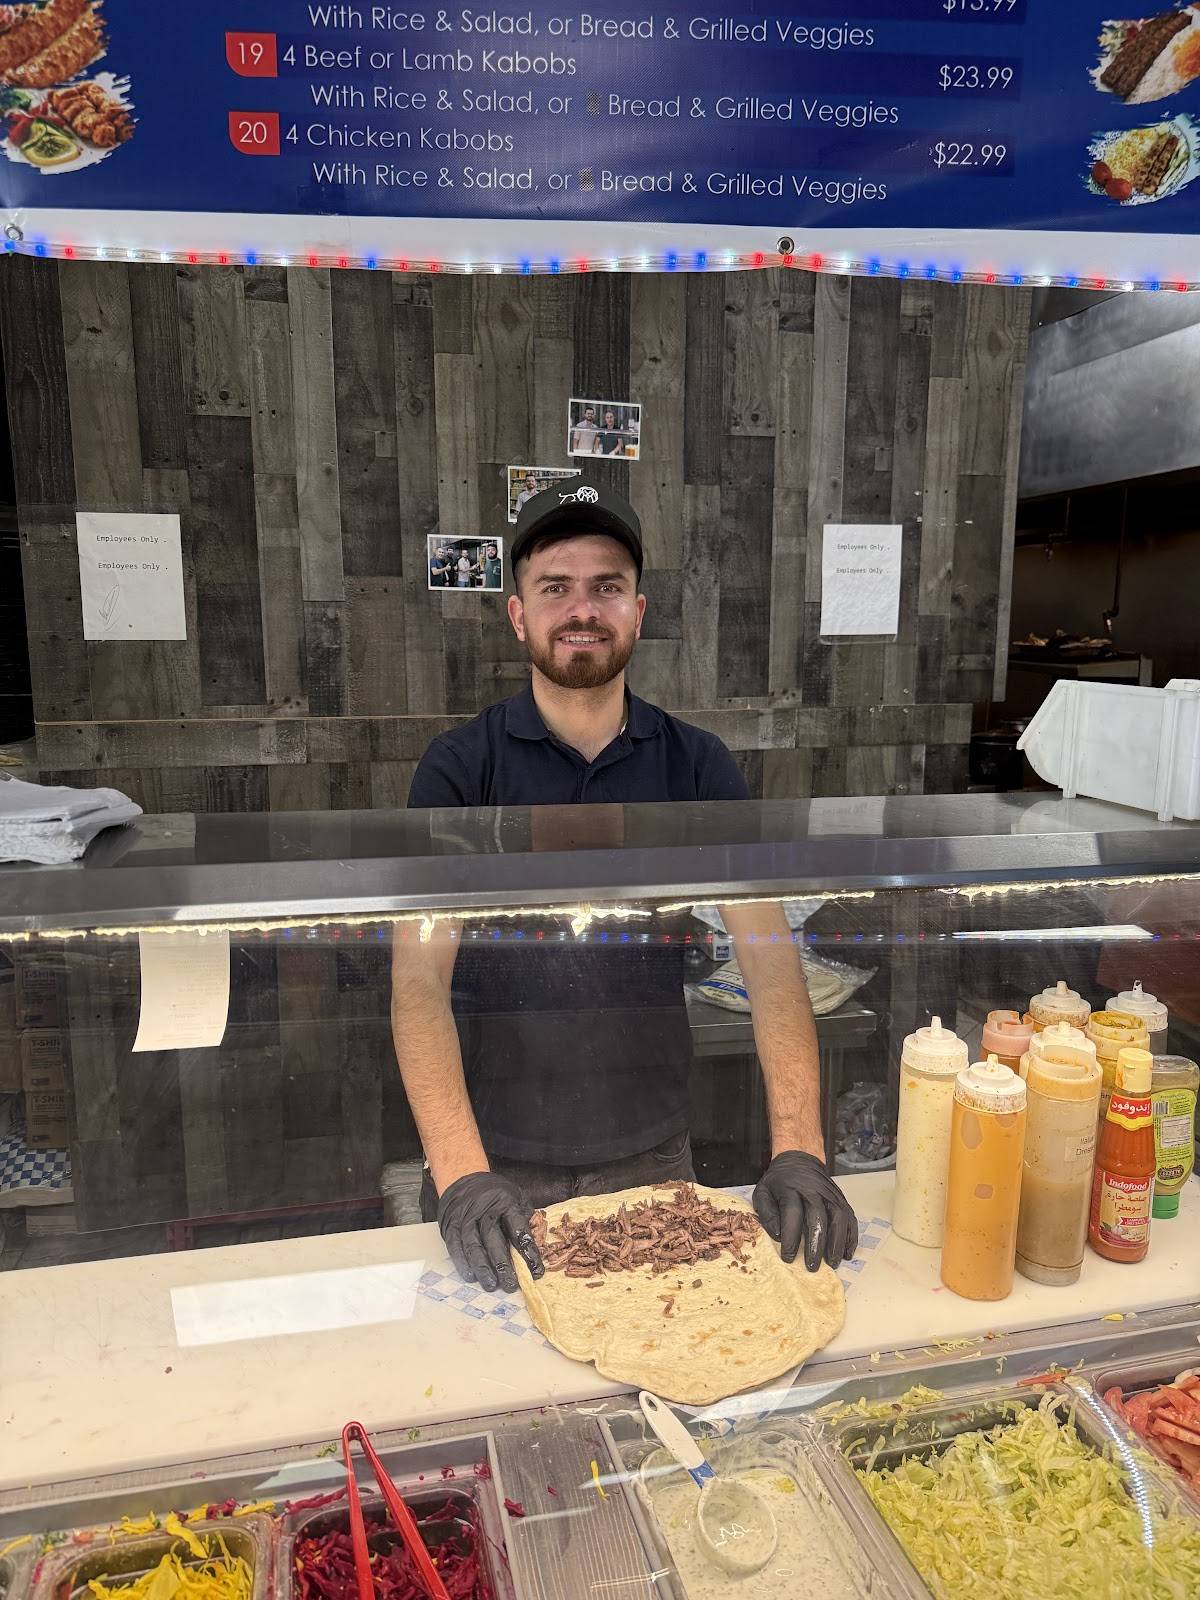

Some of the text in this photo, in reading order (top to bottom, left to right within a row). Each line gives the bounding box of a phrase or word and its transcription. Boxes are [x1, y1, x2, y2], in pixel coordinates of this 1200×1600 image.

[308, 4, 874, 50] With Rice & Salad, or Bread & Grilled Veggies
[238, 42, 577, 76] 19 4 Beef or Lamb Kabobs
[938, 63, 1013, 91] $23.99
[310, 84, 899, 128] With Rice & Salad, or Bread & Grilled Veggies
[238, 121, 514, 153] 20 4 Chicken Kabobs
[933, 141, 1007, 169] $22.99
[312, 162, 887, 205] With Rice & Salad, or Bread & Grilled Veggies
[96, 534, 137, 543] Employees
[140, 535, 159, 544] Only
[98, 562, 138, 570] Employees
[142, 562, 160, 571] Only
[1108, 1178, 1148, 1193] Indofood
